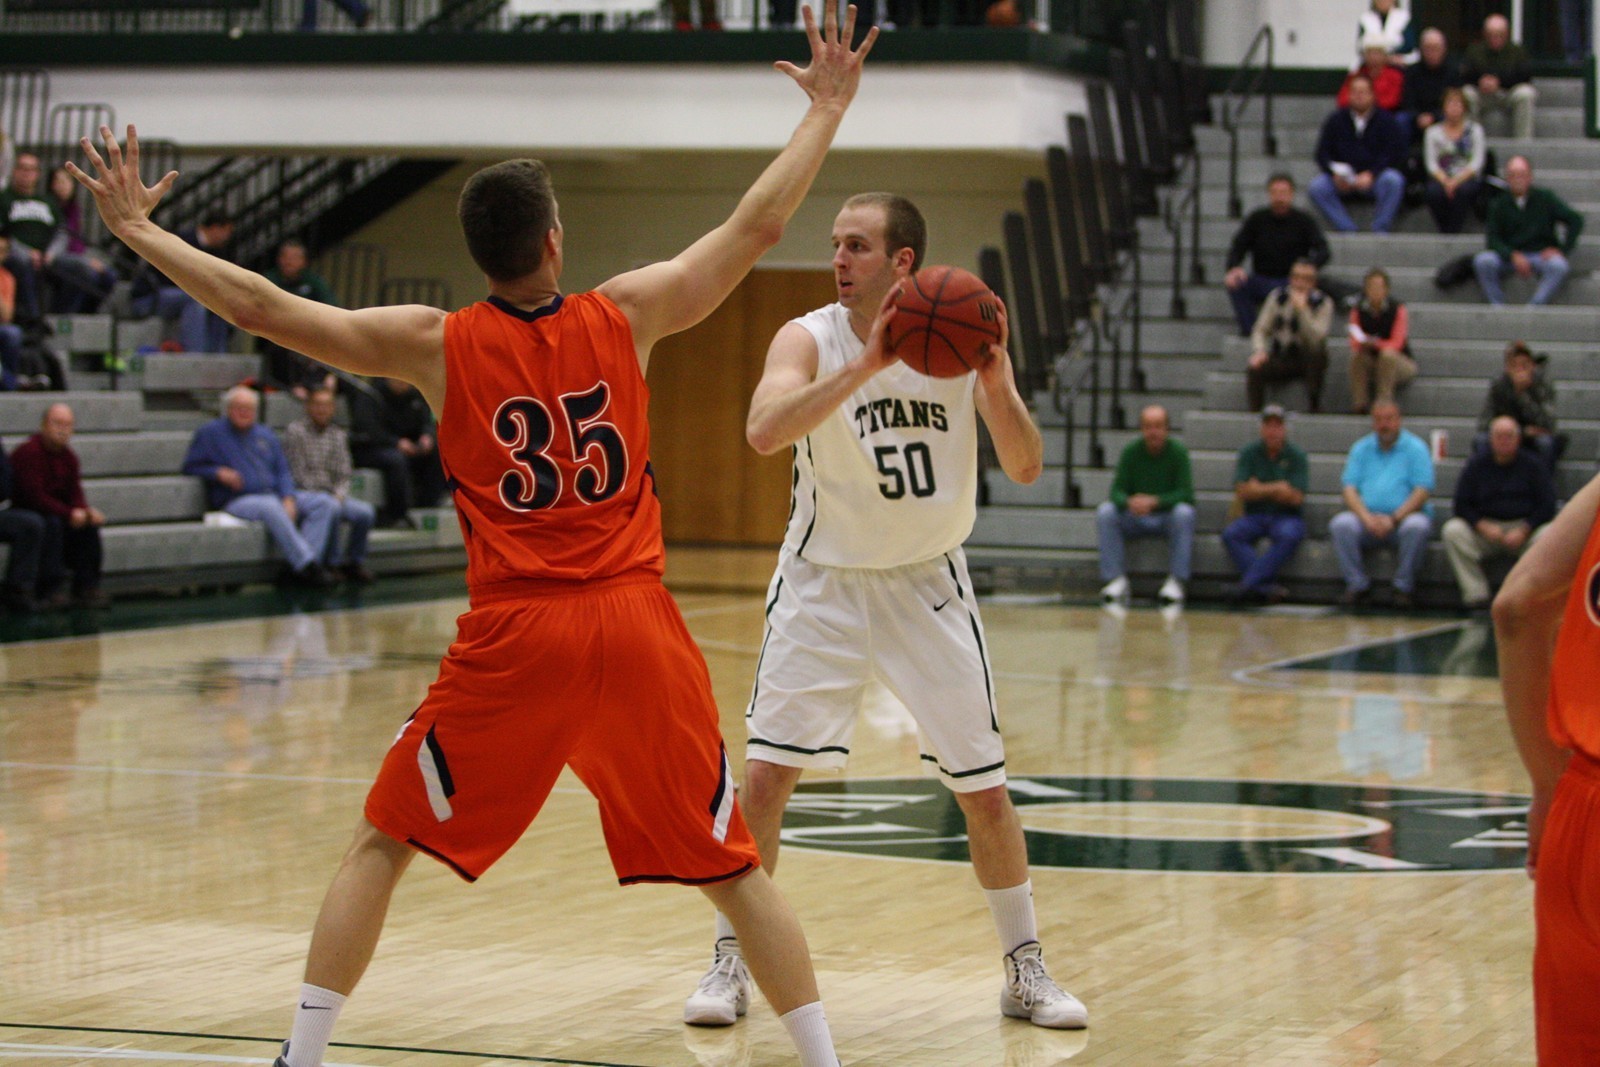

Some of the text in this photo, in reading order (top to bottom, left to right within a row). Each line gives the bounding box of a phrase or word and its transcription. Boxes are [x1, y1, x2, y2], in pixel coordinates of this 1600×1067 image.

[492, 380, 629, 512] 35
[855, 397, 948, 438] TITANS
[874, 441, 936, 500] 50
